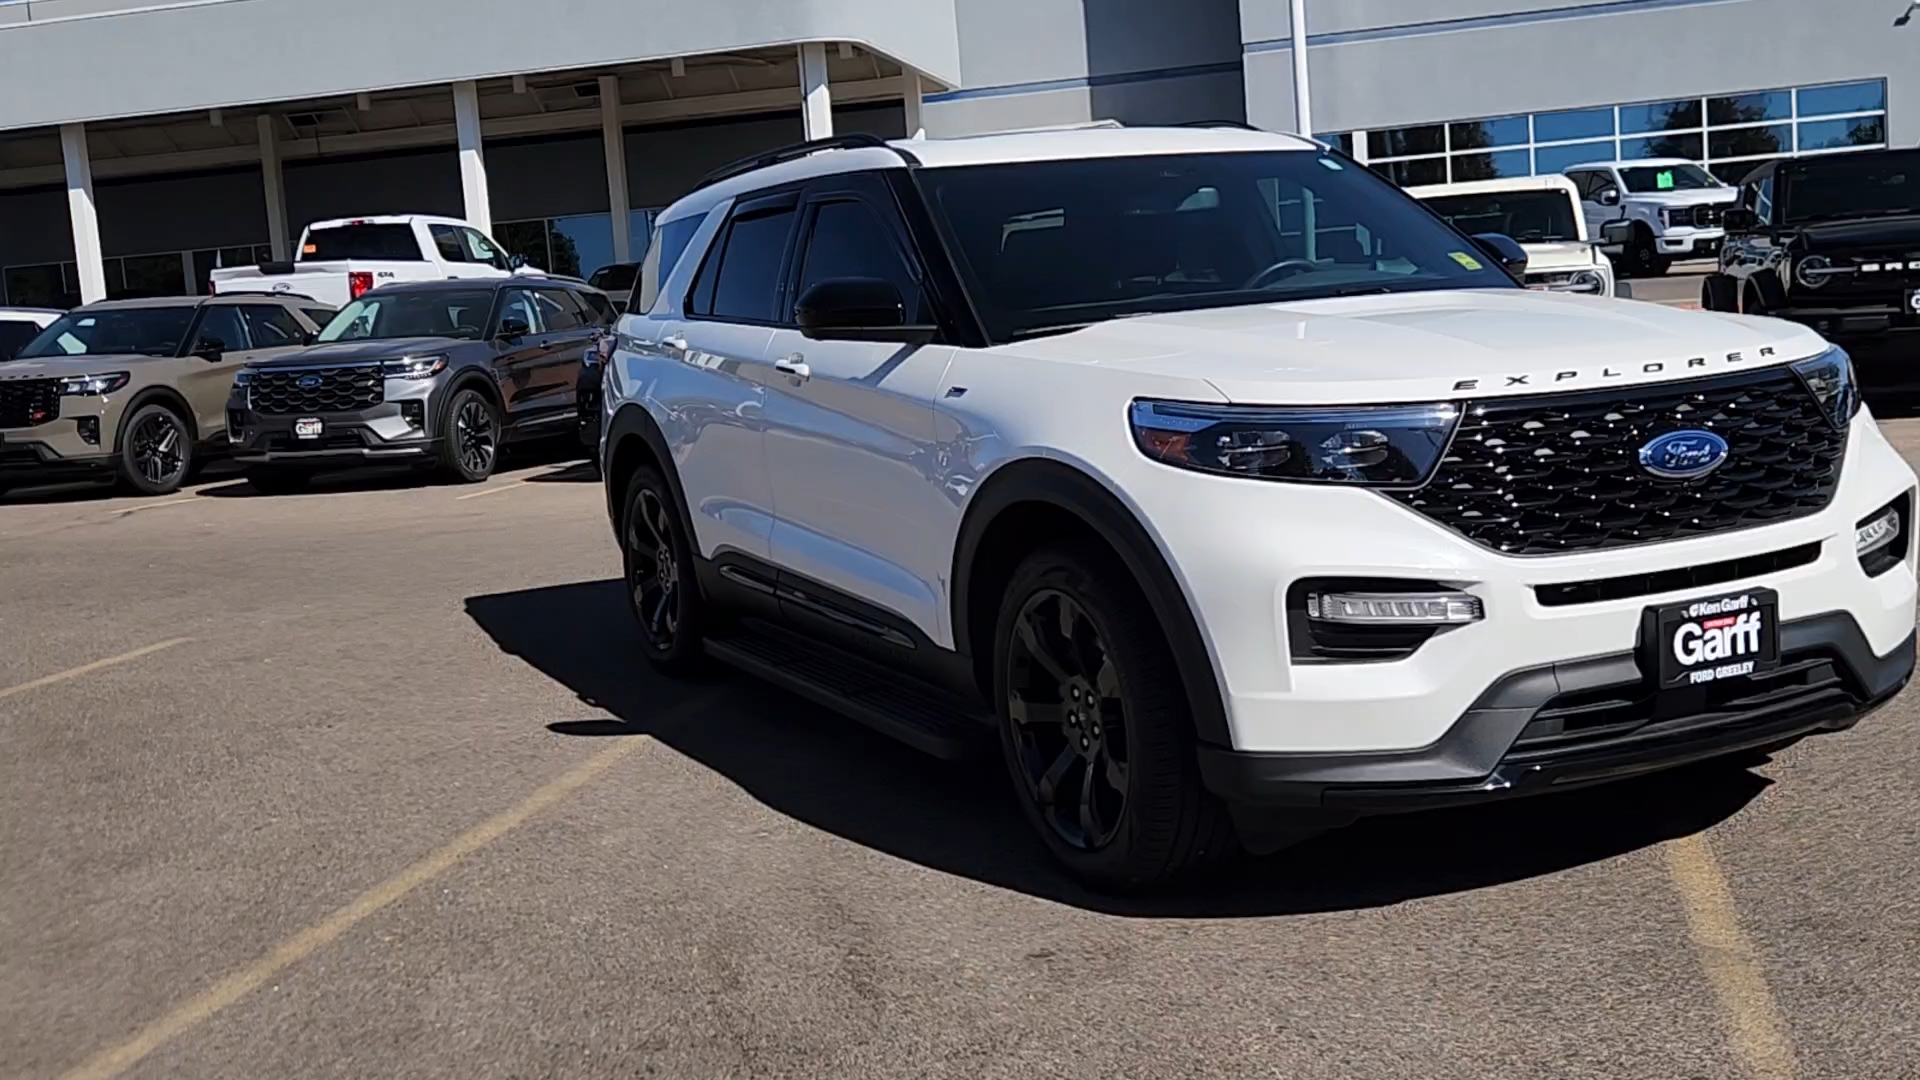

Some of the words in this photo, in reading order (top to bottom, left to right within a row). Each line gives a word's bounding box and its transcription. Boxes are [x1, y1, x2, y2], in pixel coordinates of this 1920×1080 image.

[1452, 346, 1775, 391] EXPLORER
[1699, 601, 1722, 616] Ken
[1721, 595, 1749, 613] Garff
[1673, 611, 1761, 666] Garff
[1689, 668, 1715, 685] FORD
[1715, 660, 1755, 679] GREELEY
